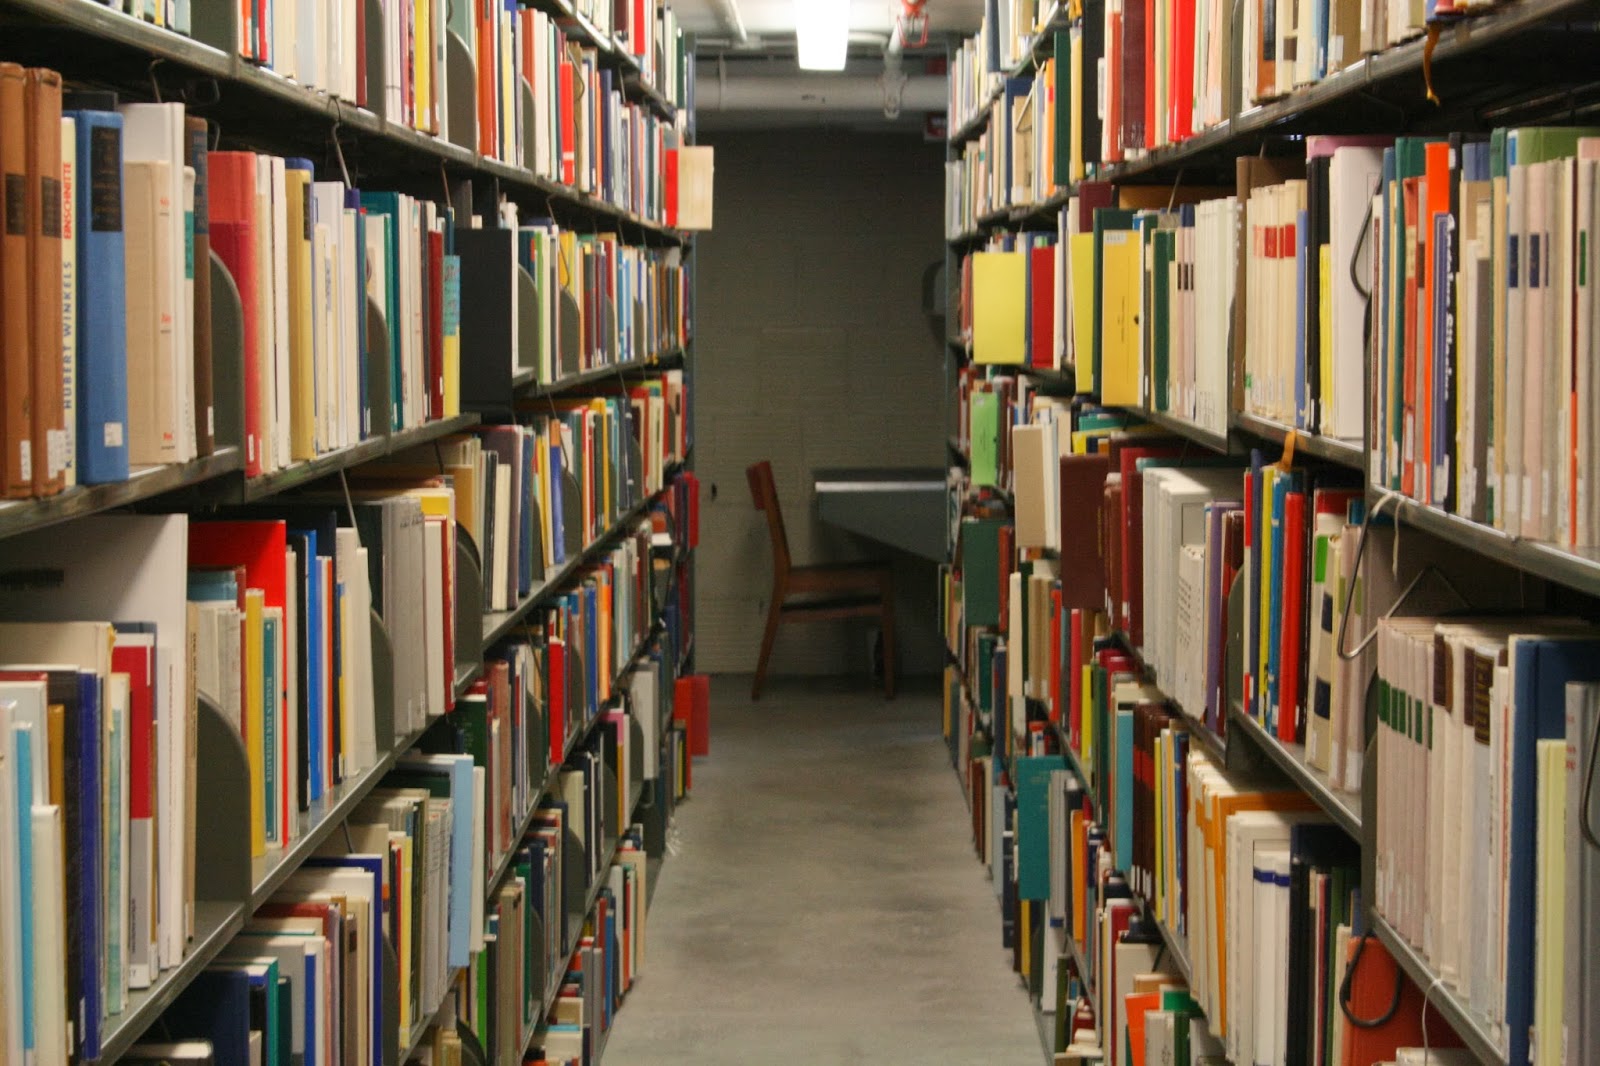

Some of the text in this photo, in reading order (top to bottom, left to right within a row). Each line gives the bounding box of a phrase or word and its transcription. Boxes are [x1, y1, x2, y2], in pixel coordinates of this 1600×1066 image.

[63, 162, 72, 239] EINSCHNITTE
[63, 261, 72, 409] HUBERT WINKELS
